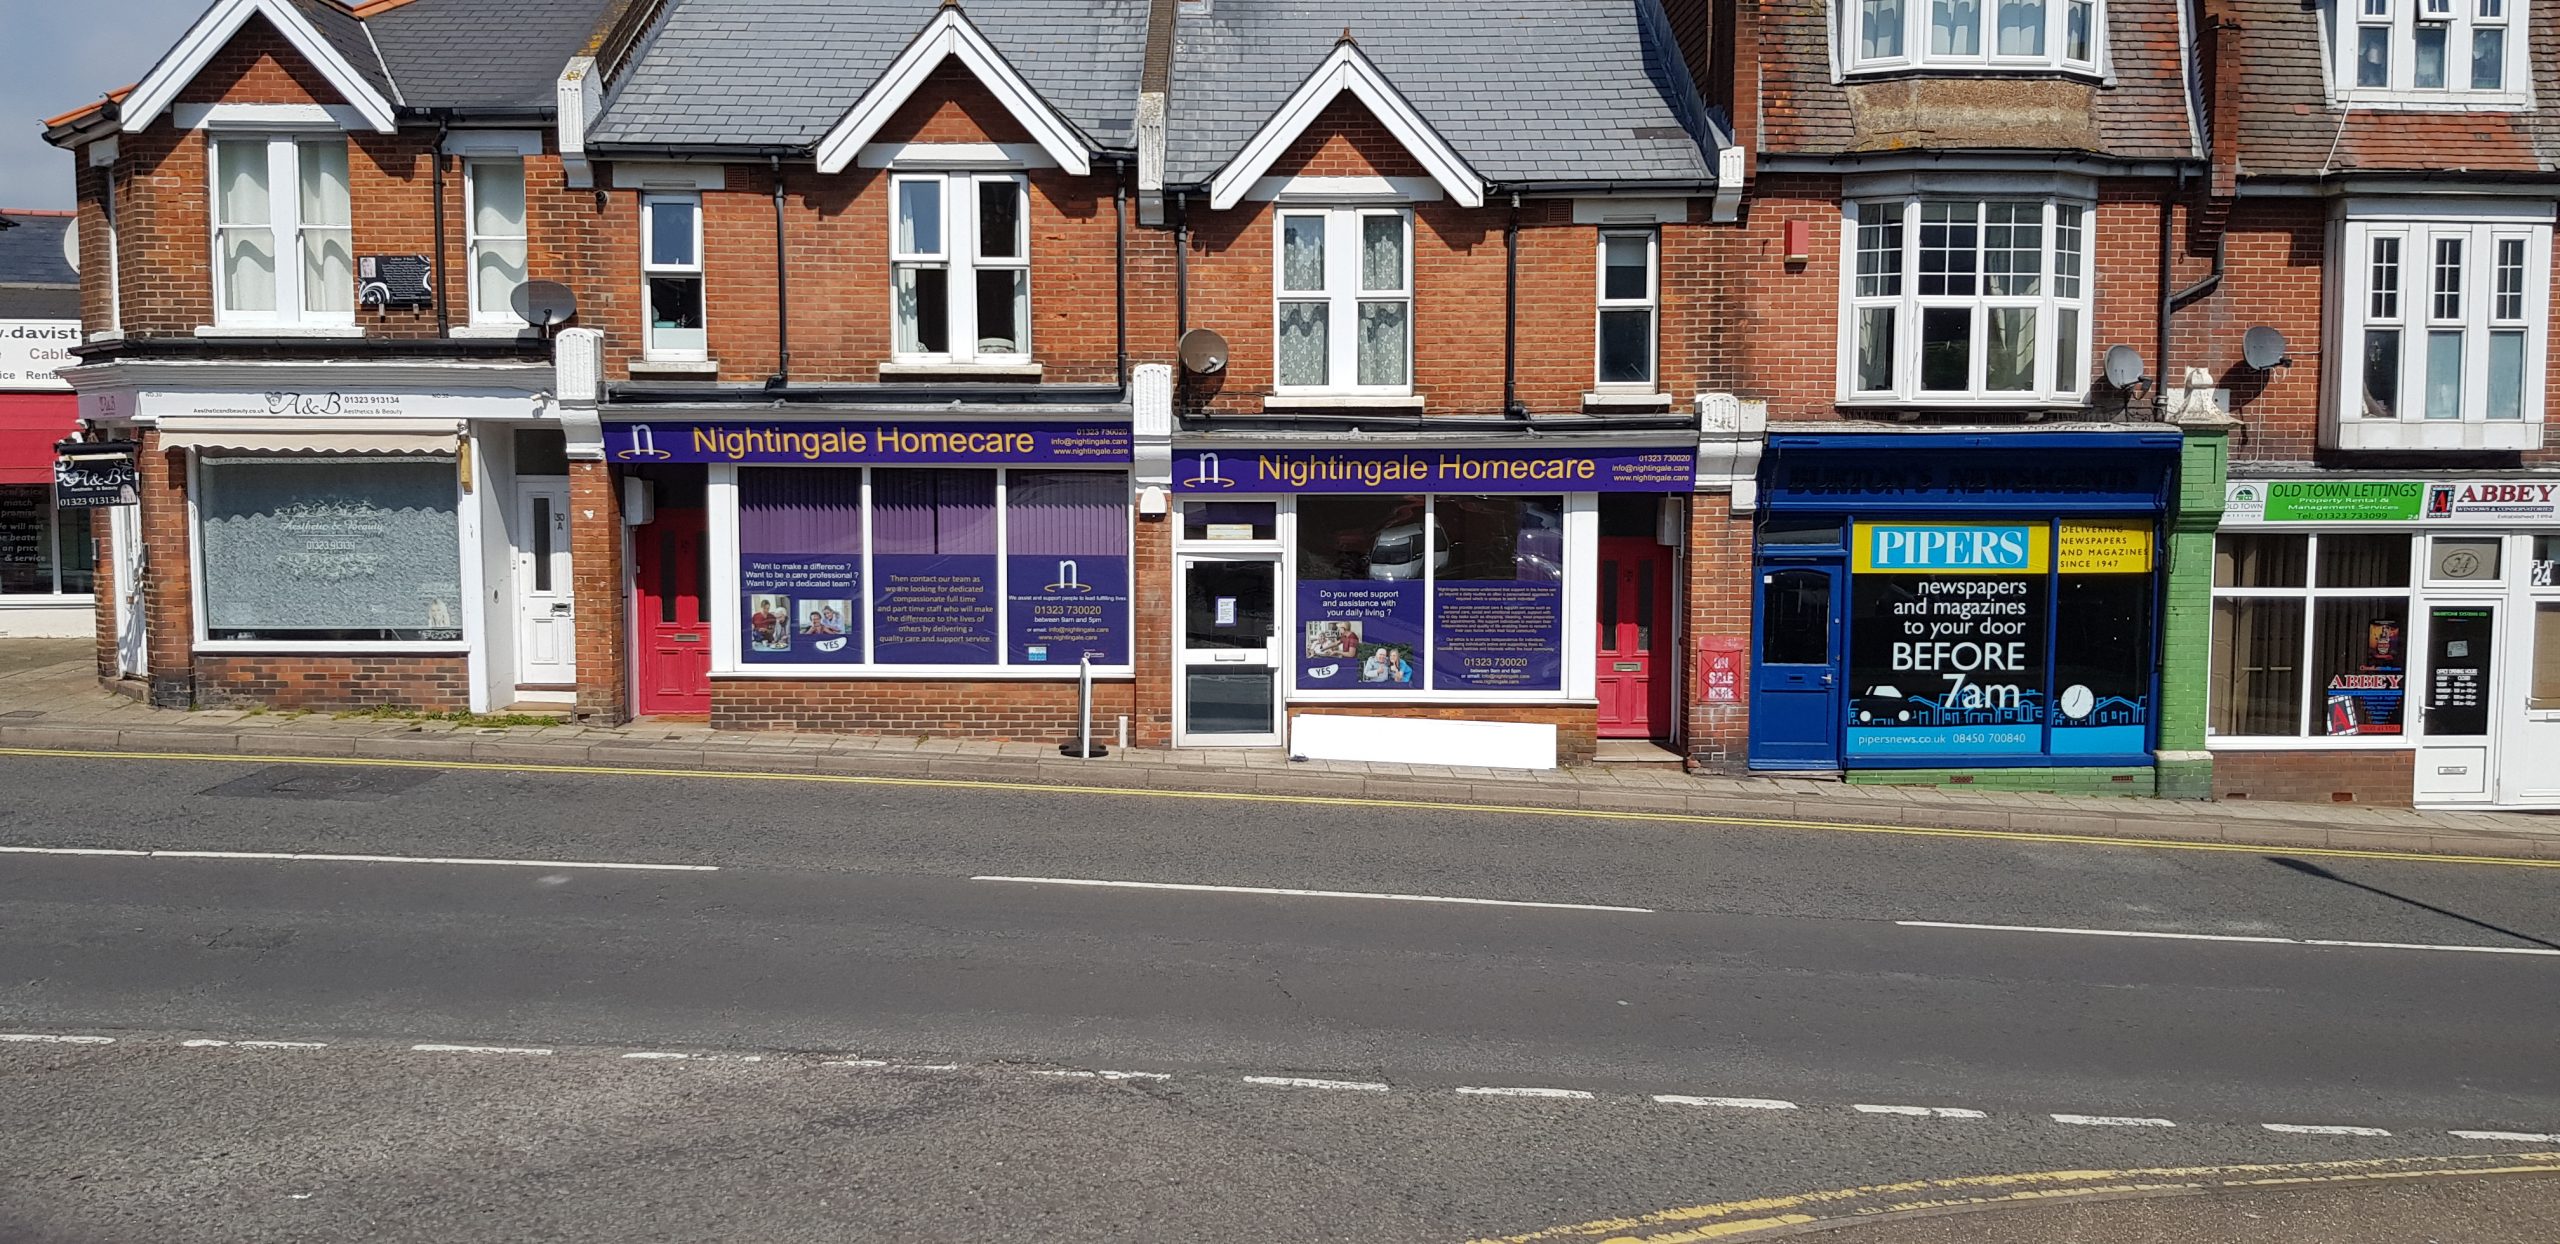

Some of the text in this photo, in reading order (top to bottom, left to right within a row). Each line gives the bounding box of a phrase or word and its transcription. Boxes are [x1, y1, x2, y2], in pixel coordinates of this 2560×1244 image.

[0, 326, 82, 340] .davist
[29, 347, 73, 360] Cable
[344, 396, 400, 404] 01323 913134
[381, 408, 403, 416] Beauty
[1076, 428, 1100, 436] 01323
[692, 426, 1035, 460] Nightingale Homecare
[1051, 437, 1128, 447] info@nightingale.care
[1053, 447, 1129, 456] www.nightingale.care
[1638, 454, 1691, 462] 01323 730020
[1258, 453, 1596, 487] Nightingale Homecare
[1611, 464, 1690, 473] info@nightingale.care
[1613, 474, 1689, 483] www.nightingale.care
[2272, 484, 2417, 498] OLD TOWN LETTINGS
[2457, 484, 2558, 503] ABBEY
[60, 496, 120, 507] 01323 913134
[2297, 512, 2388, 520] Tel: 01323 733099
[2061, 526, 2123, 534] DELIVERING
[1875, 530, 2024, 566] PIPERS
[2088, 548, 2149, 556] MAGAZINES
[752, 562, 772, 570] Want
[2060, 560, 2119, 568] SINCE 1947
[2531, 560, 2555, 569] FLAT
[745, 571, 765, 579] Want
[809, 571, 853, 580] professional
[2532, 568, 2552, 586] 24
[746, 580, 765, 588] Want
[766, 580, 774, 588] to
[775, 580, 788, 589] join
[796, 580, 831, 588] dedicated
[910, 585, 937, 594] looking
[949, 585, 984, 593] dedicated
[1320, 590, 1399, 600] Do you need support
[1917, 582, 2027, 600] newspapers
[892, 595, 946, 603] compassionate
[946, 595, 959, 603] full
[892, 605, 908, 614] part
[974, 605, 994, 613] make
[1034, 605, 1102, 615] 01323 730020
[1326, 609, 1385, 618] your daily living
[1893, 599, 2026, 620] and magazines
[900, 615, 935, 623] difference
[922, 625, 932, 634] by
[932, 625, 967, 634] delivering
[1903, 618, 2026, 640] to your door
[879, 635, 903, 644] quality
[936, 636, 964, 644] support
[823, 640, 840, 650] YES
[1892, 641, 2026, 671] BEFORE
[1464, 658, 1528, 667] 01323 730020
[1713, 657, 1729, 669] ON
[1315, 667, 1331, 677] YES
[1708, 671, 1734, 684] SALE
[2327, 674, 2404, 689] ABBEY
[1942, 673, 2020, 709] 7am
[1858, 734, 1946, 746] pipersnews.co.uk
[1952, 733, 2026, 743] 08450 700840
